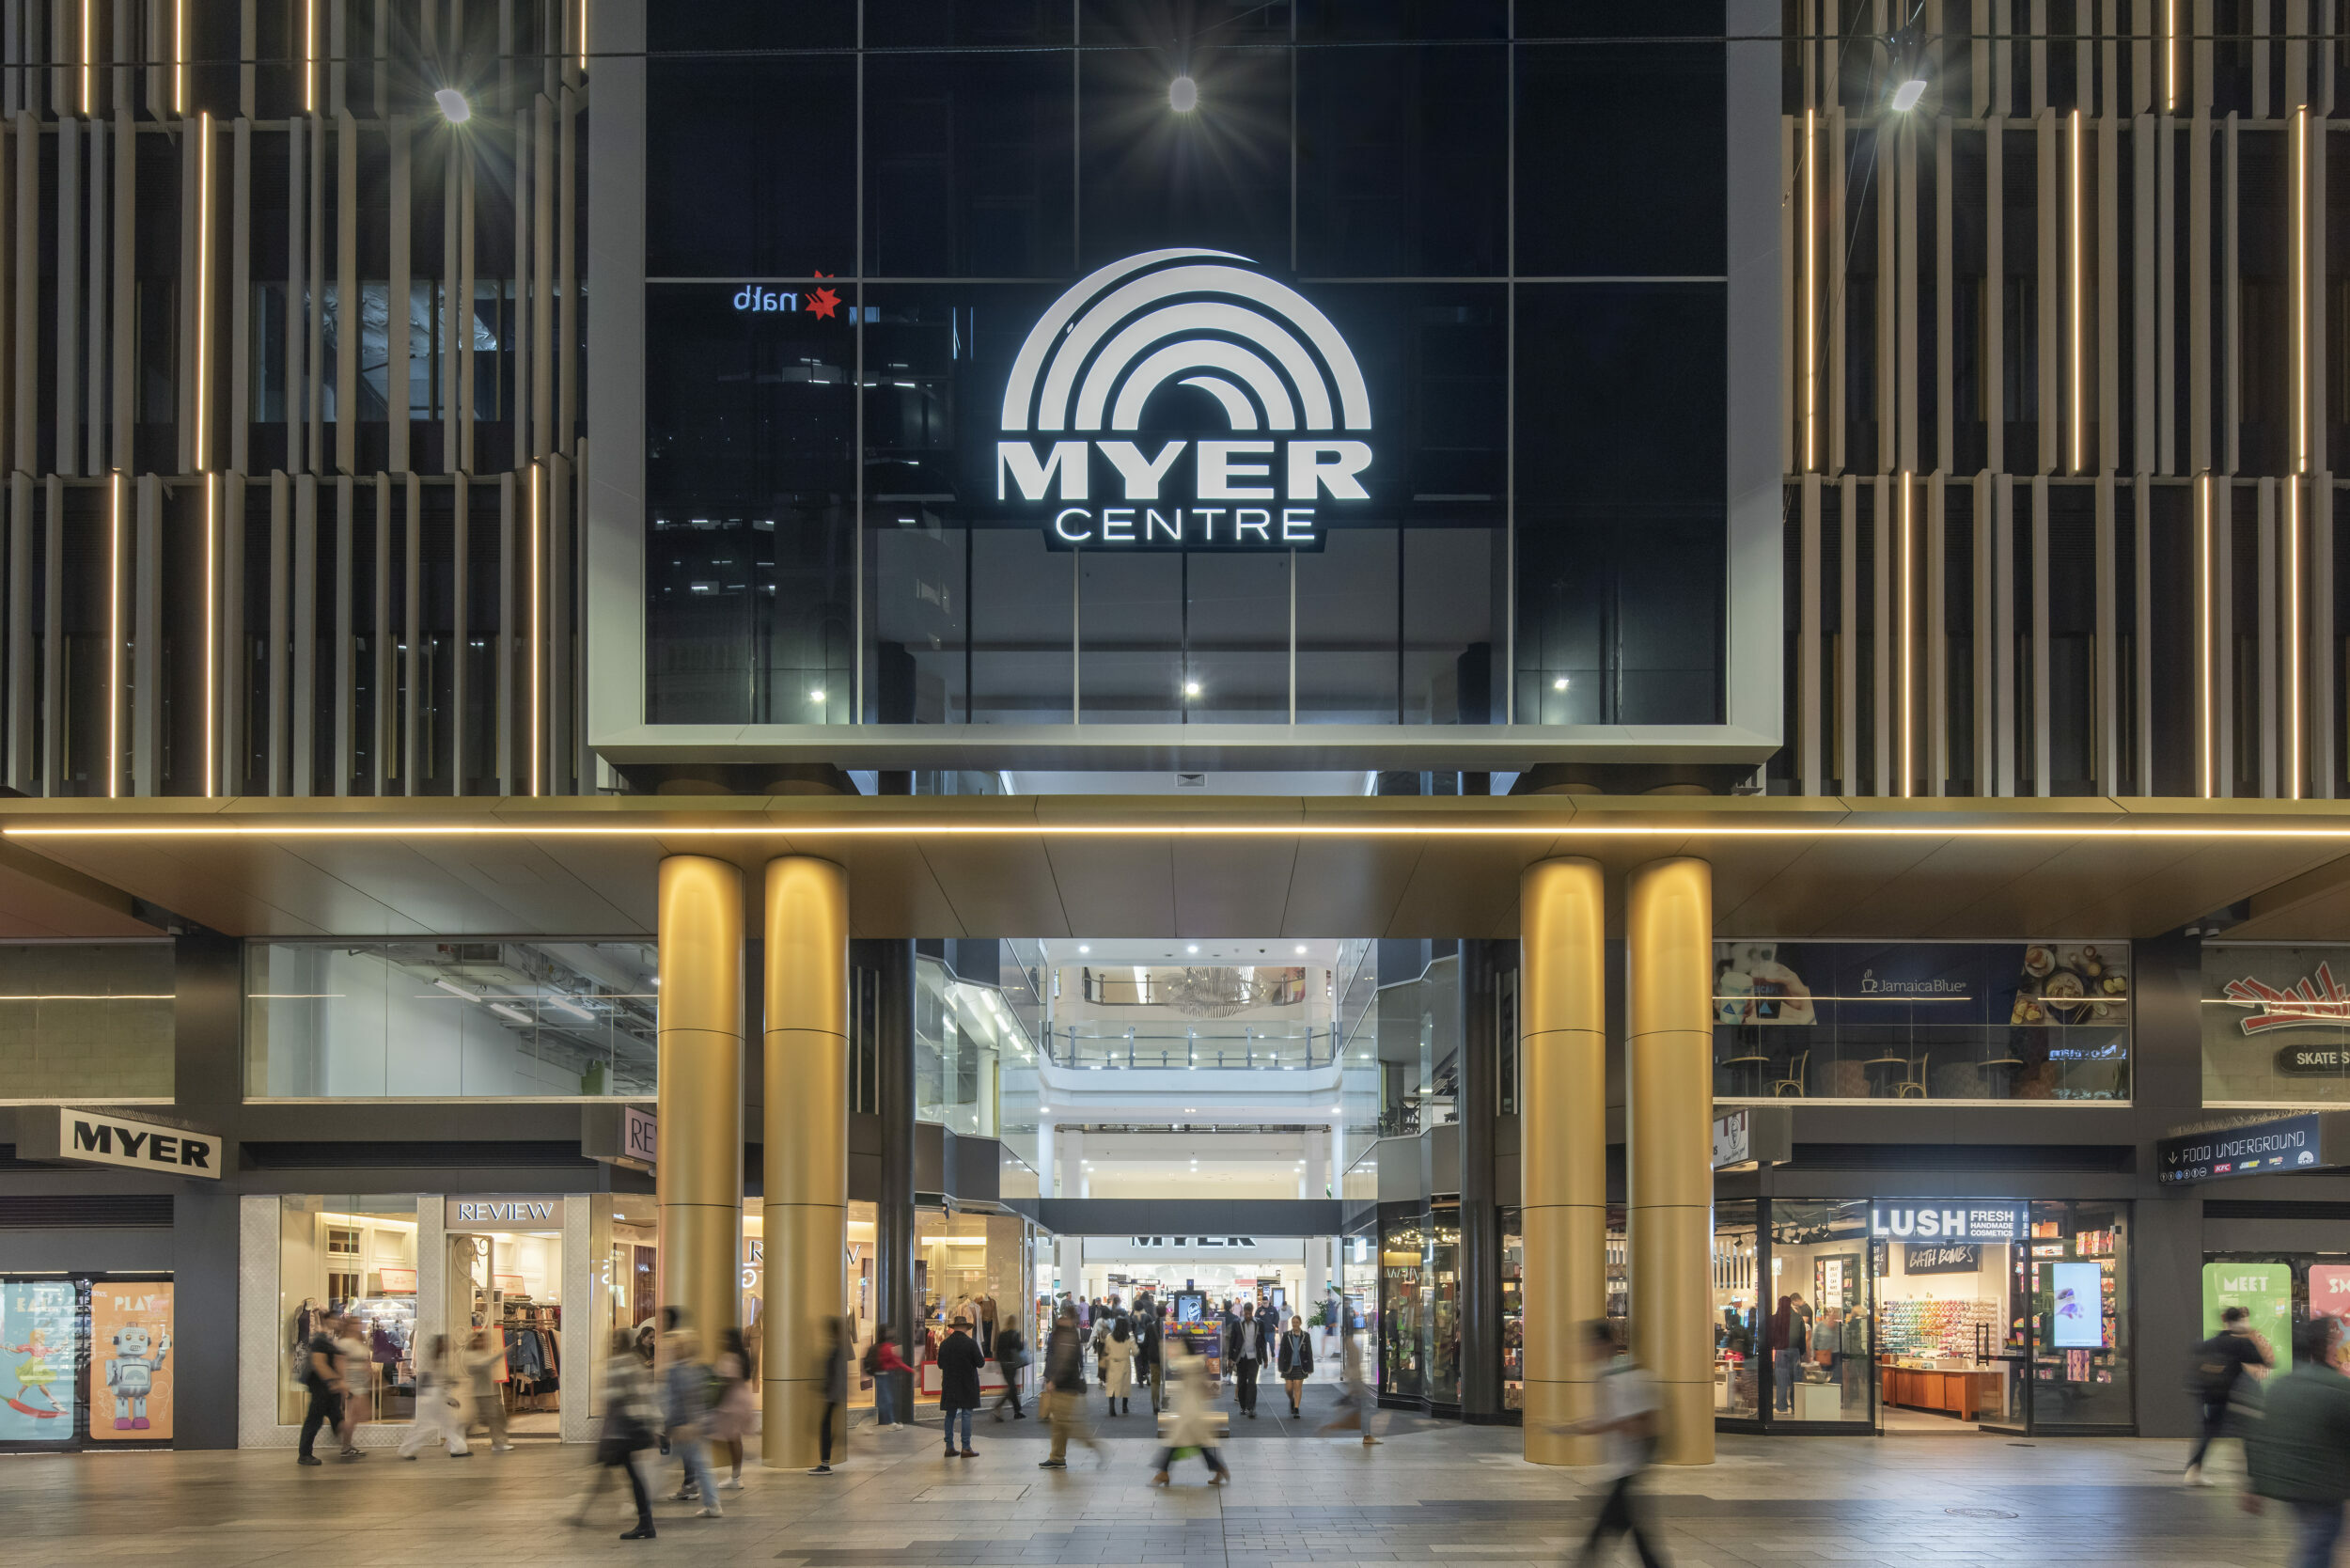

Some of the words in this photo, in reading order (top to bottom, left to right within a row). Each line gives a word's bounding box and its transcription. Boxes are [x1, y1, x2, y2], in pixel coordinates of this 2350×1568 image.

[997, 441, 1372, 500] MYER
[1056, 508, 1315, 541] CENTRE
[2296, 1052, 2338, 1065] SKATE
[2341, 1051, 2350, 1064] S
[74, 1120, 210, 1168] MYER
[2183, 1145, 2211, 1163] FOOD
[2216, 1131, 2305, 1158] UNDERGROUND
[2216, 1164, 2231, 1172] KFC
[458, 1202, 554, 1221] REVIEW
[1970, 1211, 2014, 1222] FRESH
[1872, 1209, 1966, 1237] LUSH
[1909, 1249, 1937, 1268] BATH
[1937, 1245, 1974, 1265] BOMBS
[2223, 1276, 2269, 1293] MEET
[114, 1295, 156, 1312] PLAY
